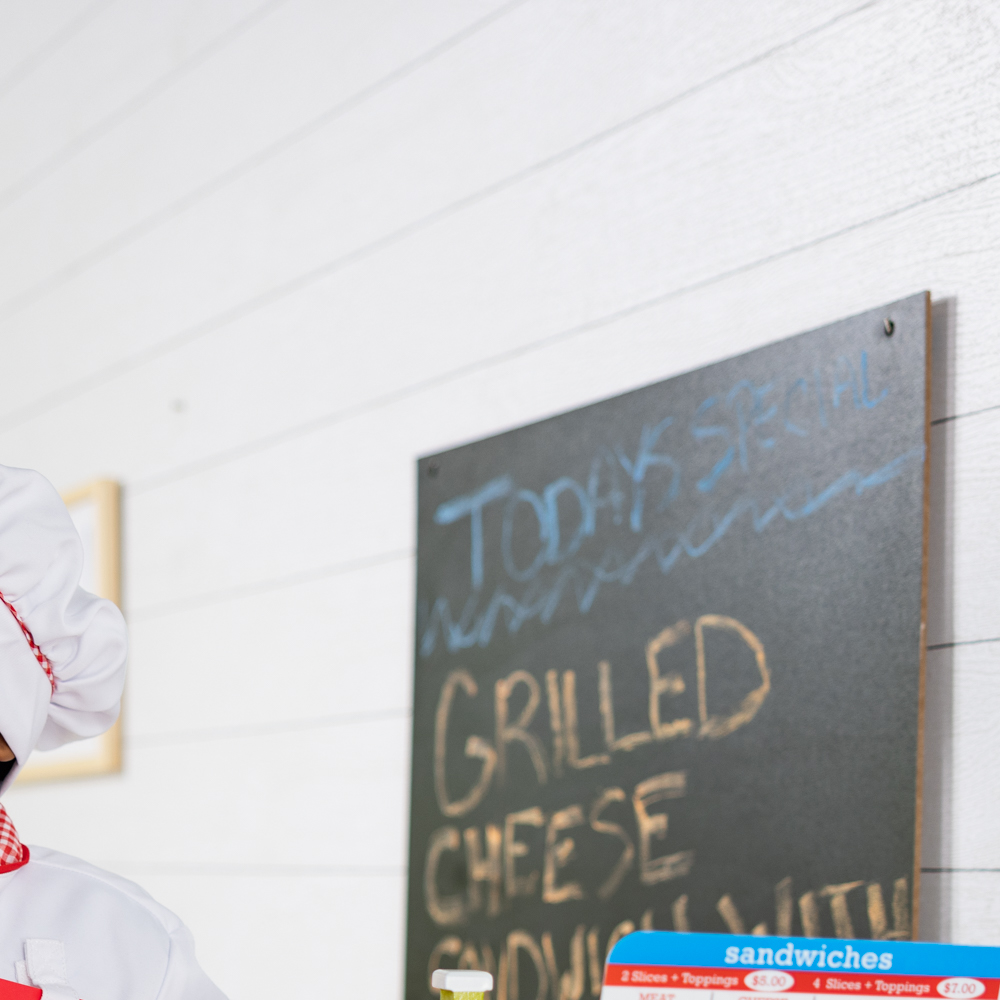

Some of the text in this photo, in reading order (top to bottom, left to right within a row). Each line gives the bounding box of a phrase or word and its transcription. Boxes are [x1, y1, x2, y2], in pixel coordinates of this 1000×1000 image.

[434, 614, 771, 818] GRILLED
[424, 770, 695, 926] CHEESE
[725, 942, 893, 970] sandwiches
[621, 971, 629, 982] 2
[631, 971, 667, 983] Slices
[681, 972, 738, 987] Toppings
[752, 975, 786, 987] $5.00
[813, 978, 821, 989] 4
[825, 978, 861, 991] Slices
[875, 980, 930, 994] Toppings
[943, 983, 976, 995] $7.00
